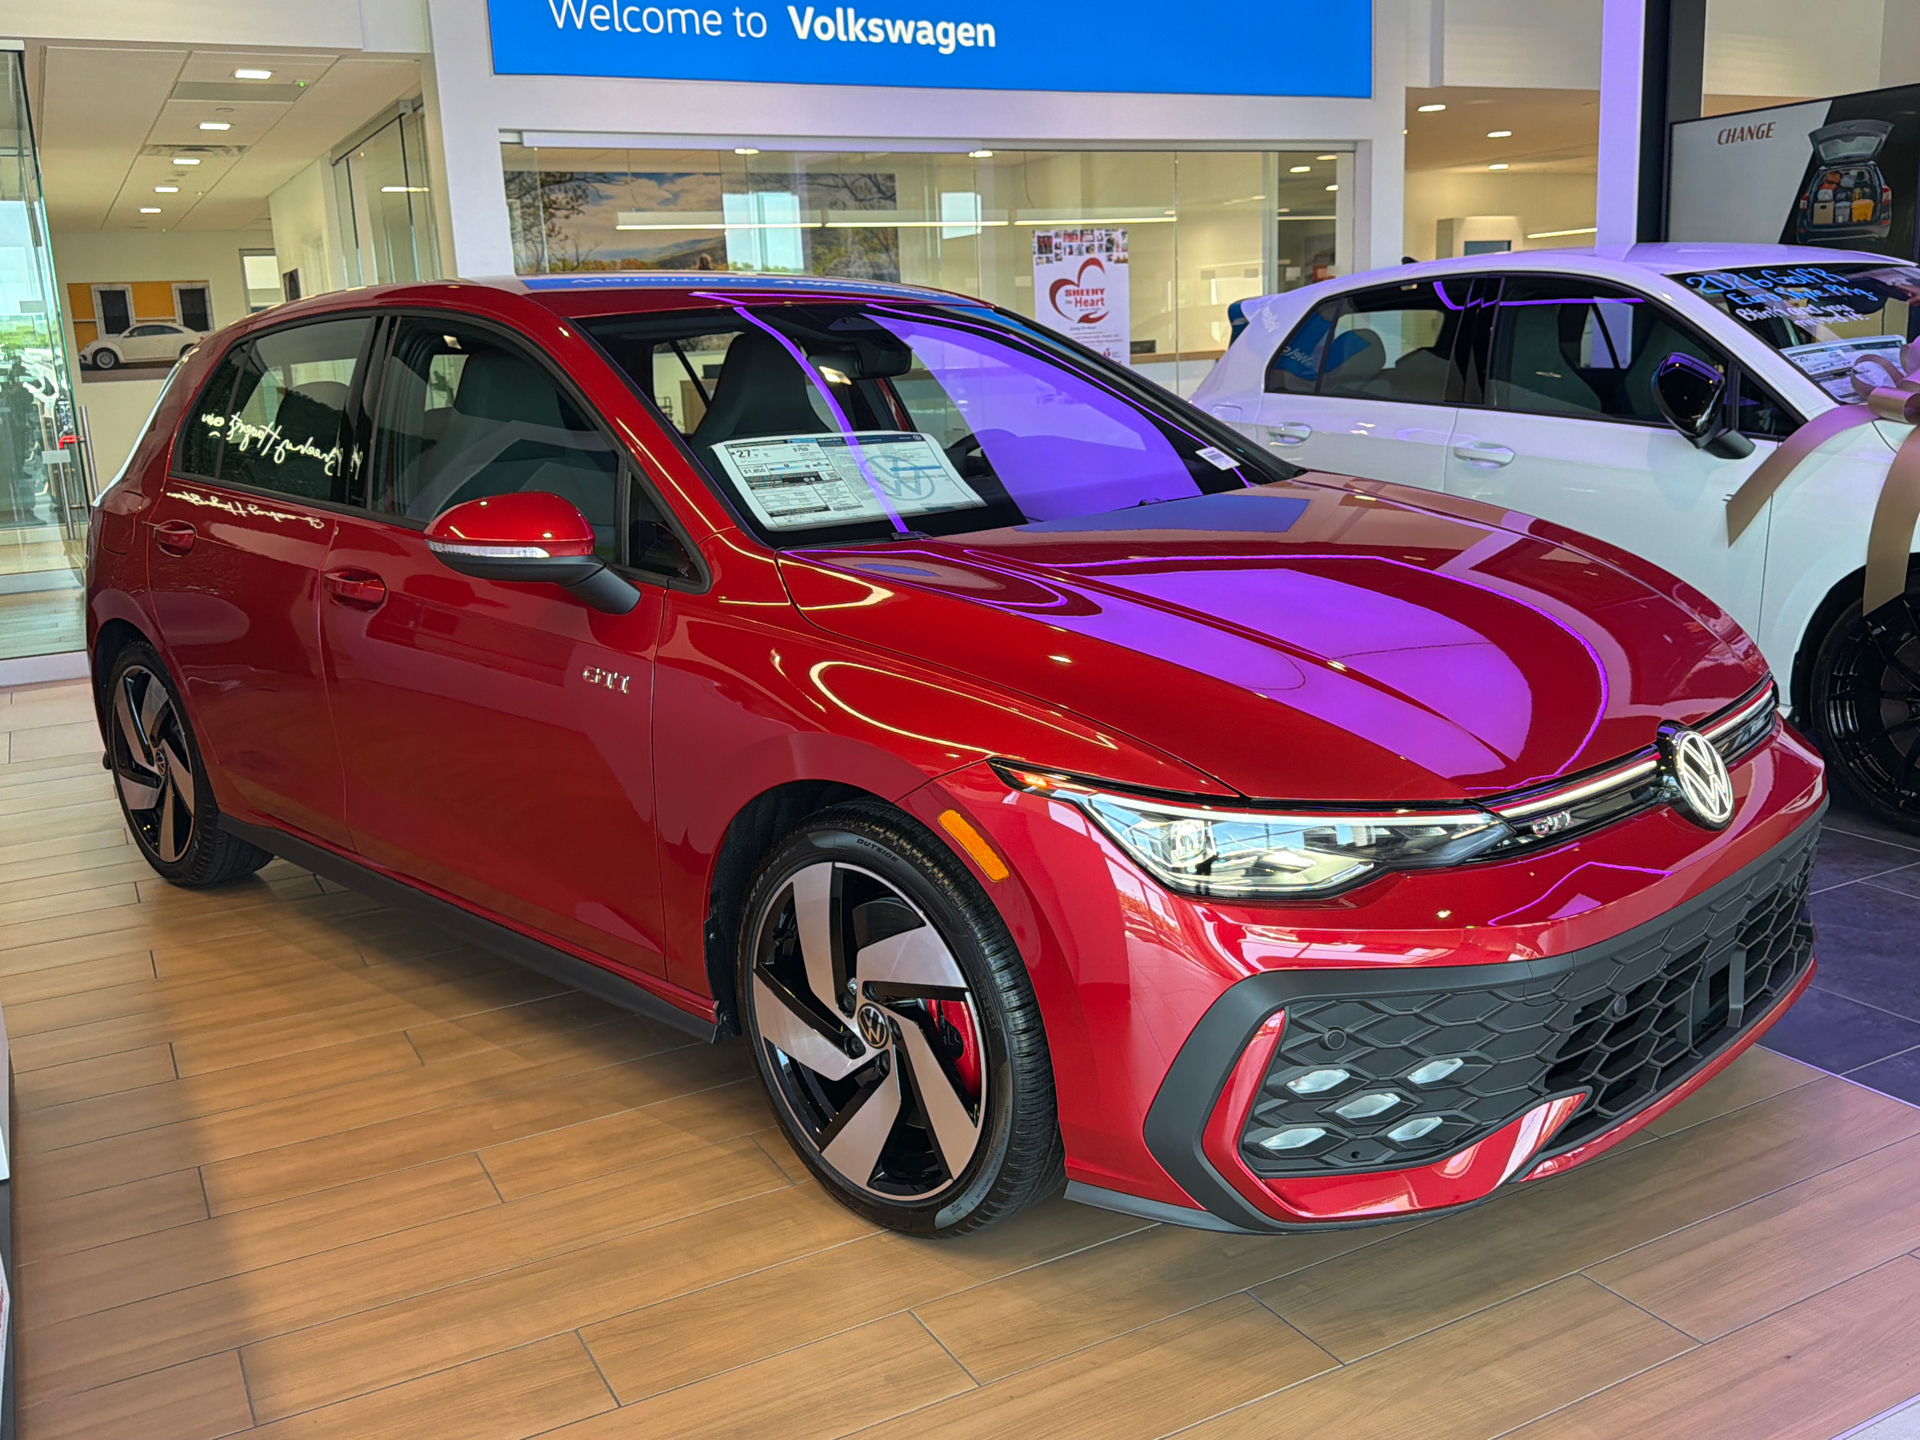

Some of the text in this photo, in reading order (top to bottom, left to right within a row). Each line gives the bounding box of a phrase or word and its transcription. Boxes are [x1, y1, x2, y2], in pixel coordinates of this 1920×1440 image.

[548, 0, 996, 55] Welcome to Volkswagen
[1717, 121, 1777, 146] CHANGE
[1064, 287, 1106, 298] SHEEHY
[1685, 272, 1774, 295] 2026
[1074, 296, 1106, 308] Heart
[1726, 292, 1783, 306] Euro
[1773, 286, 1830, 302] Style
[1786, 303, 1824, 317] and
[582, 665, 631, 694] GTI
[1532, 809, 1574, 835] GTI
[856, 838, 899, 863] OUTSIDE
